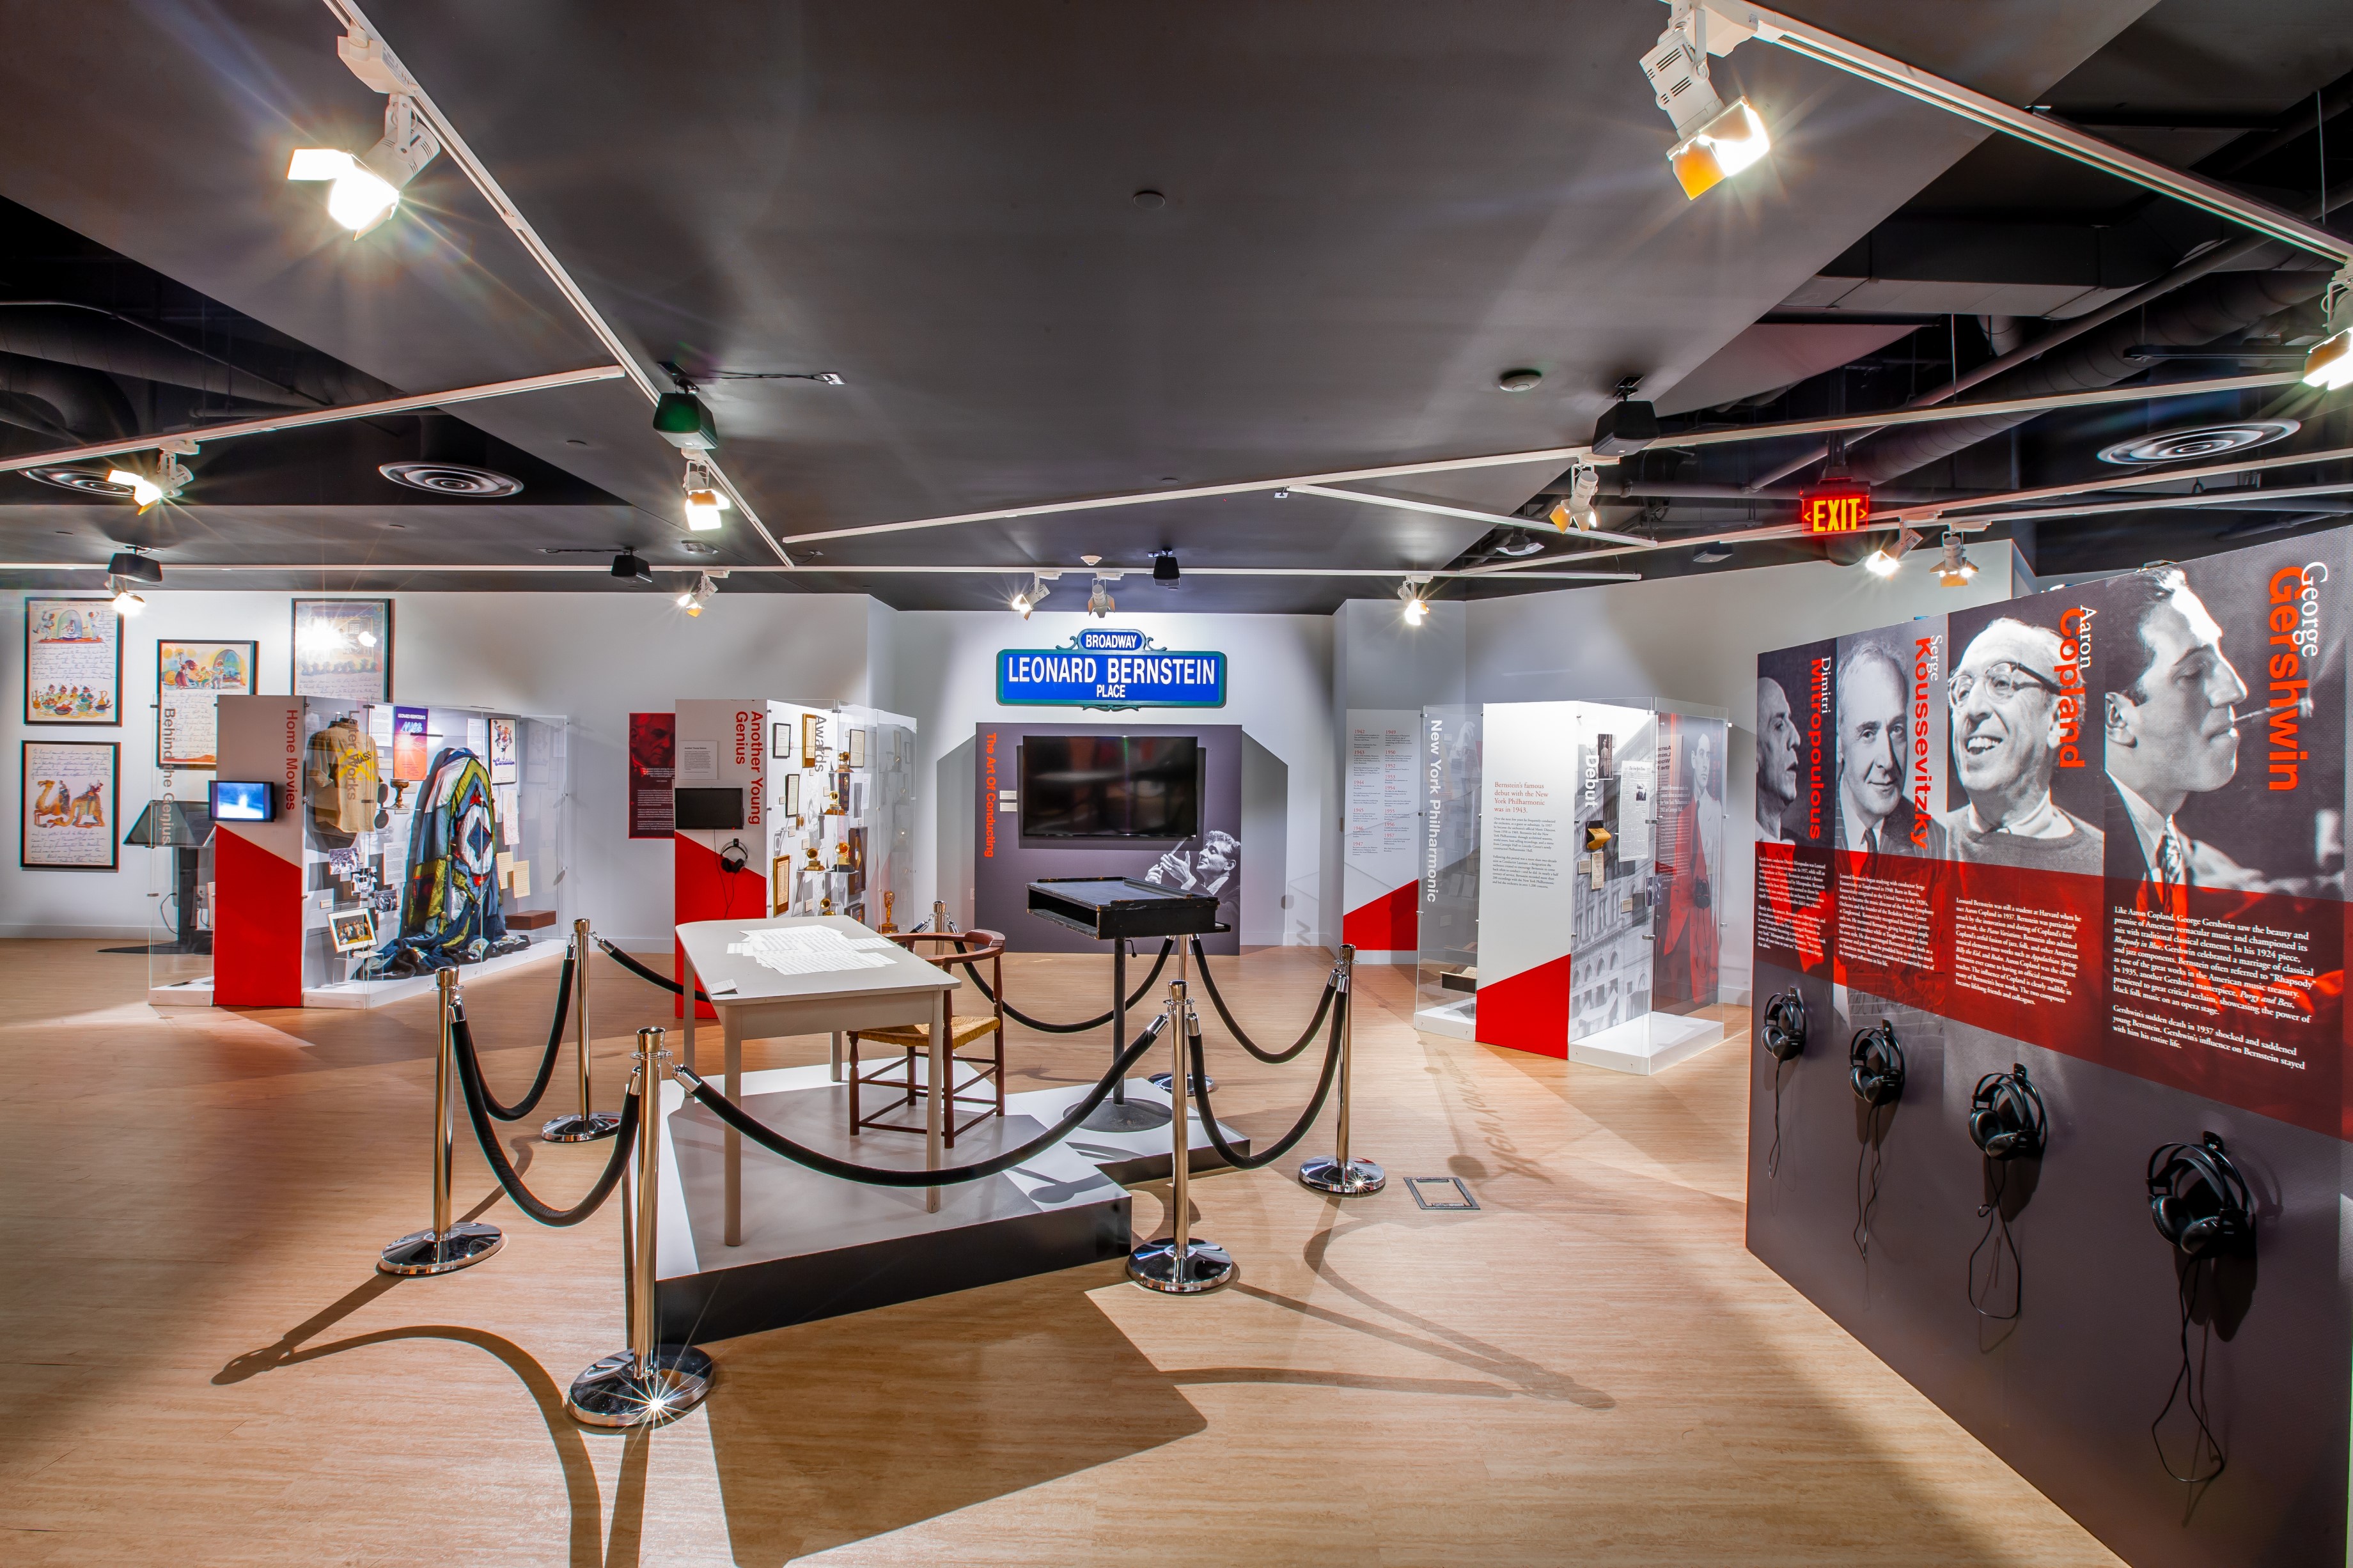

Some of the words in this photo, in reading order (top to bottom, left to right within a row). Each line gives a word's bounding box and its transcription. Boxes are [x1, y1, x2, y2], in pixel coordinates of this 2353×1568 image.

[1813, 498, 1861, 532] EXIT
[2292, 561, 2328, 657] George
[1086, 634, 1137, 648] BROADWAY
[1927, 634, 1943, 681] Serge
[2079, 605, 2097, 669] Aaron
[1008, 656, 1097, 683] LEONARD
[1107, 658, 1215, 685] BERNSTEIN
[1096, 684, 1126, 698] PLACE
[1822, 656, 1831, 715] Dimitri
[2054, 607, 2085, 768] Copland
[2269, 566, 2309, 790] Gershwin
[163, 708, 176, 759] Behind
[286, 710, 298, 754] Home
[348, 710, 359, 749] Later
[736, 711, 748, 765] Genius
[751, 711, 763, 773] Another
[815, 715, 827, 772] Awards
[987, 733, 997, 754] The
[1430, 720, 1442, 755] New
[1808, 658, 1824, 840] Mitropoulous
[1910, 637, 1933, 850] Koussevitzky
[163, 763, 175, 788] the
[347, 753, 359, 800] Works
[354, 750, 372, 766] MASS
[987, 757, 997, 773] Art
[1430, 758, 1442, 794] York
[286, 757, 298, 811] Movies
[748, 777, 763, 825] Young
[986, 777, 996, 791] Of
[1584, 754, 1599, 808] Debut
[162, 792, 175, 846] Genius
[984, 793, 997, 858] Conducting
[1427, 800, 1441, 903] Philharmonic
[2145, 921, 2174, 931] American
[2176, 927, 2210, 936] vernacular
[2248, 936, 2296, 949] championed
[2298, 943, 2307, 951] its
[2147, 911, 2175, 921] Copland,
[2177, 915, 2201, 926] George
[2202, 918, 2235, 929] Gershwin
[2252, 925, 2264, 933] the
[2266, 926, 2292, 939] beauty
[2114, 936, 2139, 947] Rhapsody
[2148, 941, 2163, 950] Blue,
[2164, 944, 2195, 955] Gershwin
[2197, 950, 2230, 962] celebrated
[2238, 959, 2271, 970] marriage
[2282, 964, 2313, 976] classical
[2141, 931, 2171, 941] traditional
[2173, 935, 2198, 945] classical
[2200, 939, 2232, 951] elements.
[2244, 946, 2254, 954] his
[2257, 949, 2275, 958] 1924
[2277, 952, 2300, 963] piece,
[2122, 967, 2138, 976] 1935,
[2139, 973, 2162, 981] another
[2164, 975, 2194, 987] Gershwin
[2196, 984, 2237, 996] masterpiece,
[2240, 990, 2259, 1002] Porgy
[2277, 998, 2294, 1008] Bess,
[2138, 952, 2176, 962] components.
[2178, 957, 2208, 968] Bernstein
[2210, 963, 2228, 972] often
[2230, 967, 2257, 978] referred
[2269, 973, 2316, 989] "Rhapsody"
[2208, 974, 2241, 986] American
[2244, 982, 2265, 990] music
[2267, 986, 2299, 998] treasury.
[2113, 977, 2141, 987] premiered
[2167, 988, 2188, 997] critical
[2190, 993, 2217, 1003] acclaim,
[2219, 997, 2260, 1014] showcasing
[2261, 1006, 2274, 1015] the
[2275, 1011, 2300, 1020] power
[2113, 984, 2128, 994] black
[2130, 988, 2141, 996] folk
[2201, 1006, 2219, 1015] stage.
[2113, 1005, 2144, 1017] Gershwin's
[2145, 1014, 2166, 1023] sudden
[2168, 1018, 2185, 1028] death
[2197, 1025, 2213, 1034] 1937
[2215, 1029, 2243, 1042] shocked
[2261, 1042, 2296, 1055] saddened
